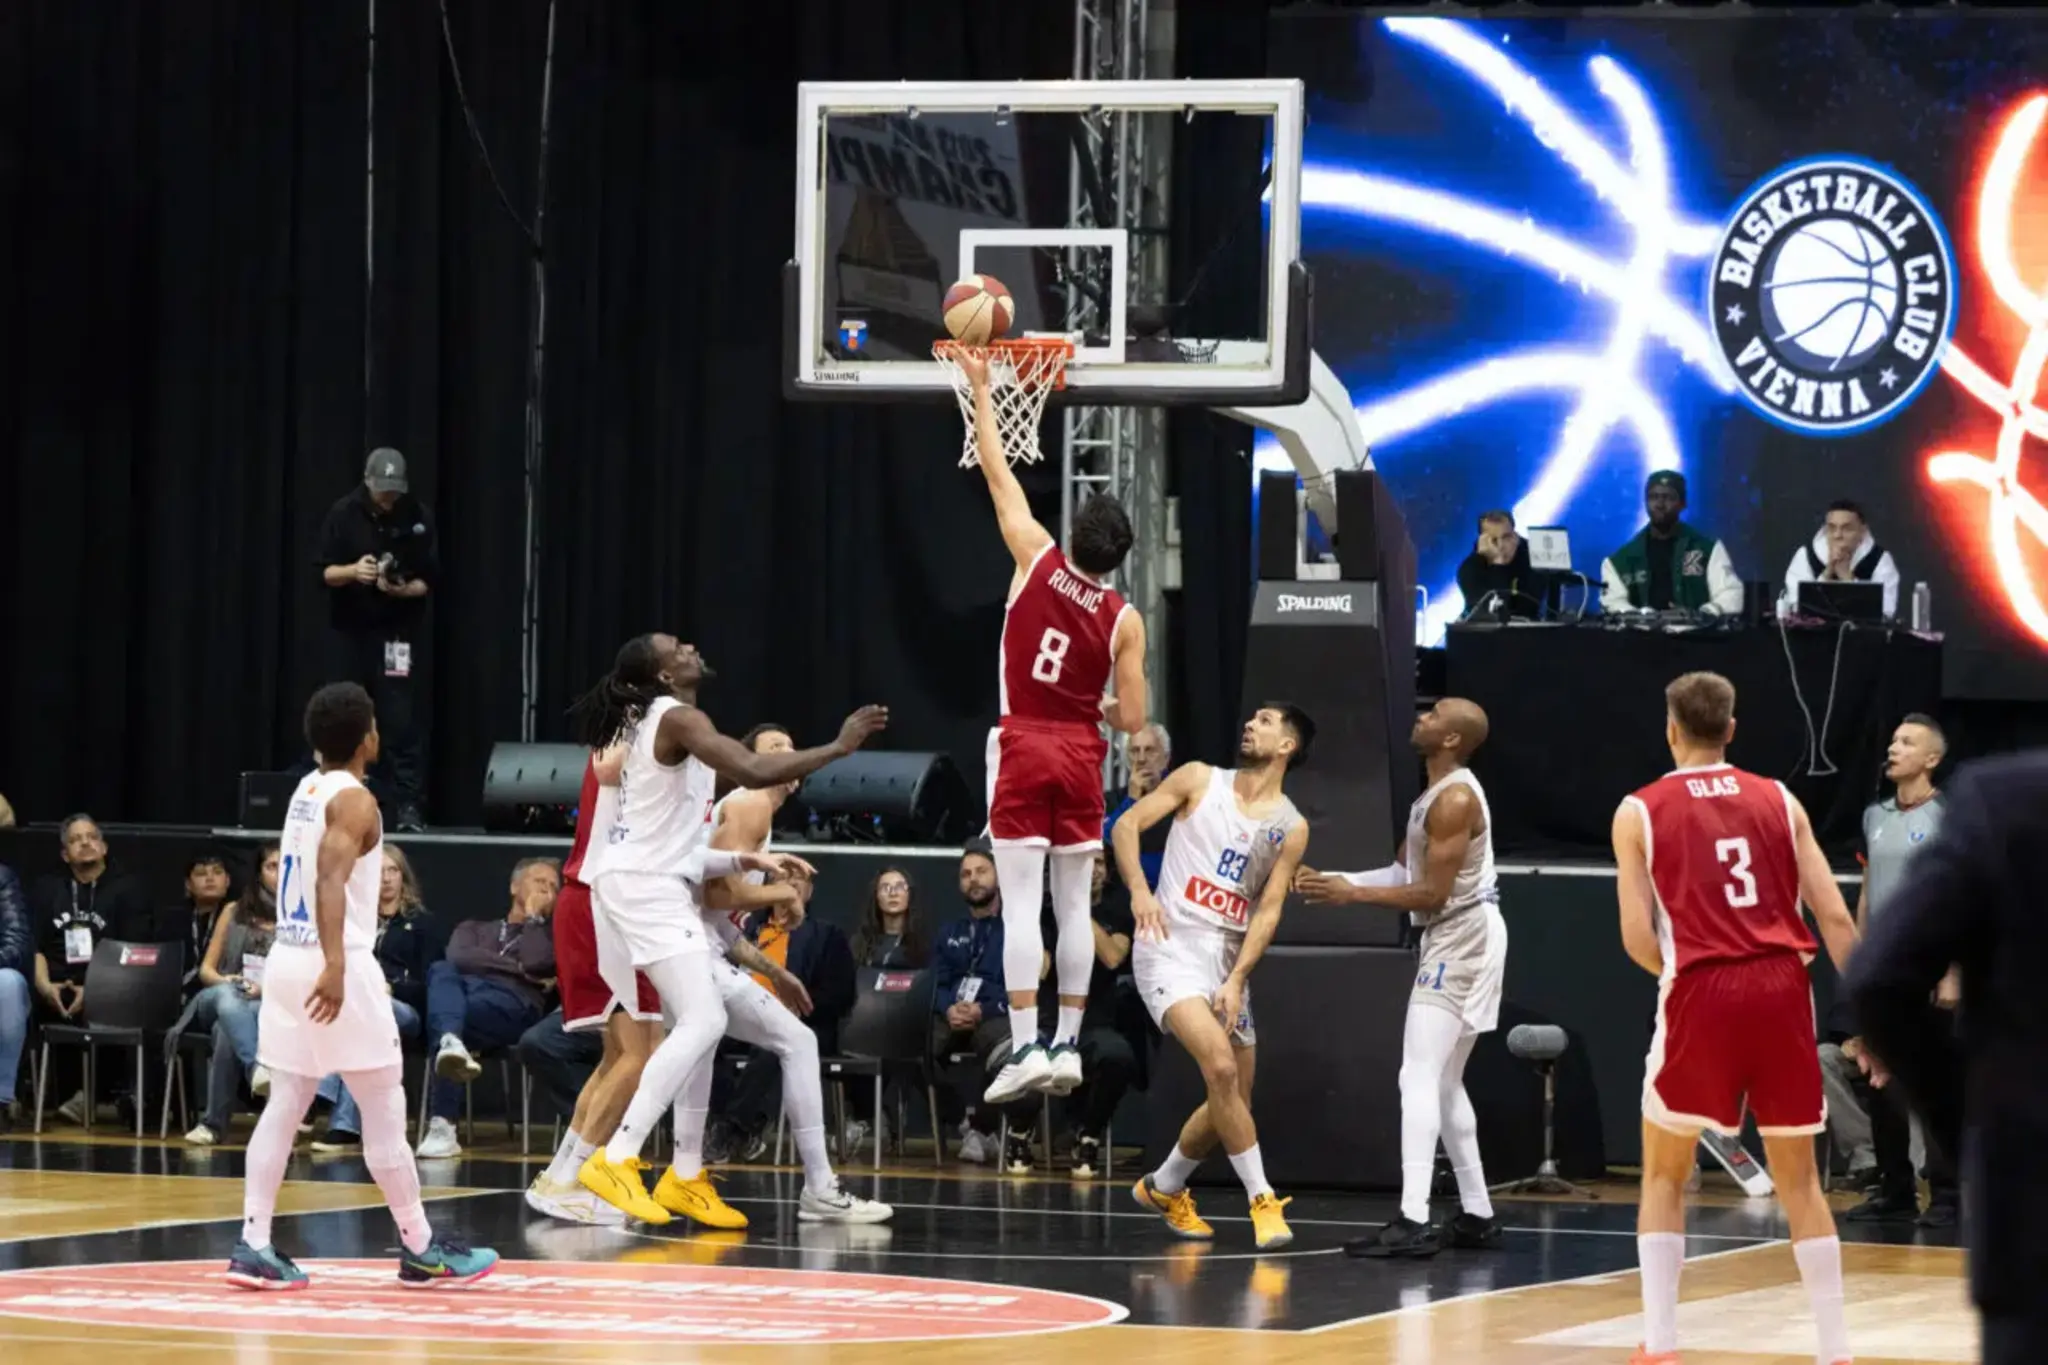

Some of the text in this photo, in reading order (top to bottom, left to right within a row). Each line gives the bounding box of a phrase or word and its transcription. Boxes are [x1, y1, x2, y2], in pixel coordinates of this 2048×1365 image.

[1720, 174, 1940, 361] BASKETBALL CLUB
[1735, 335, 1872, 418] VIENNA
[1276, 594, 1352, 613] SPALDING
[1031, 627, 1071, 683] 8
[1685, 775, 1741, 799] GLAS
[1216, 848, 1249, 883] 83
[1715, 836, 1759, 908] 3
[1193, 881, 1244, 920] VOLI
